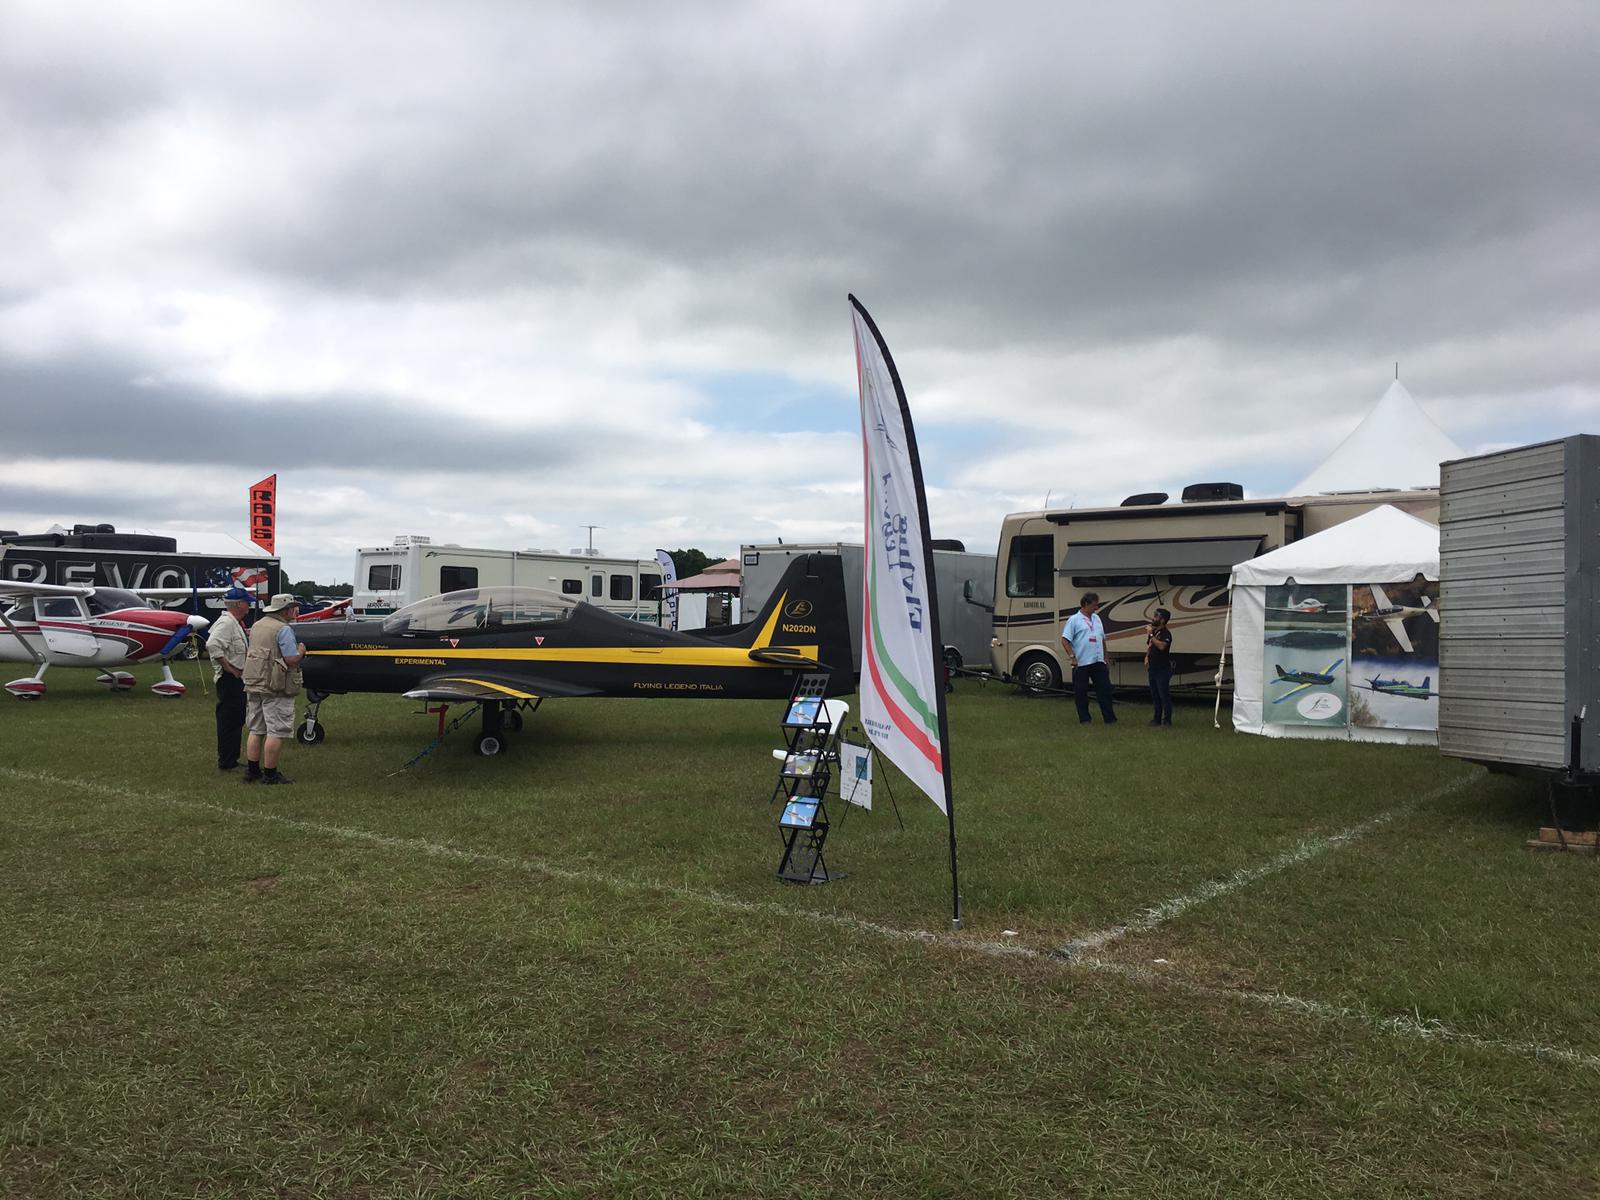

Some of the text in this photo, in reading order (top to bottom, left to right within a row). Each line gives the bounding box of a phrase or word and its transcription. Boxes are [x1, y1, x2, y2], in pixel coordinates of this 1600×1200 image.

[1, 558, 191, 607] REVO
[782, 623, 817, 634] N202DN
[394, 657, 447, 666] EXPERIMENTAL
[633, 682, 724, 691] FLYING LEGEND ITALIA
